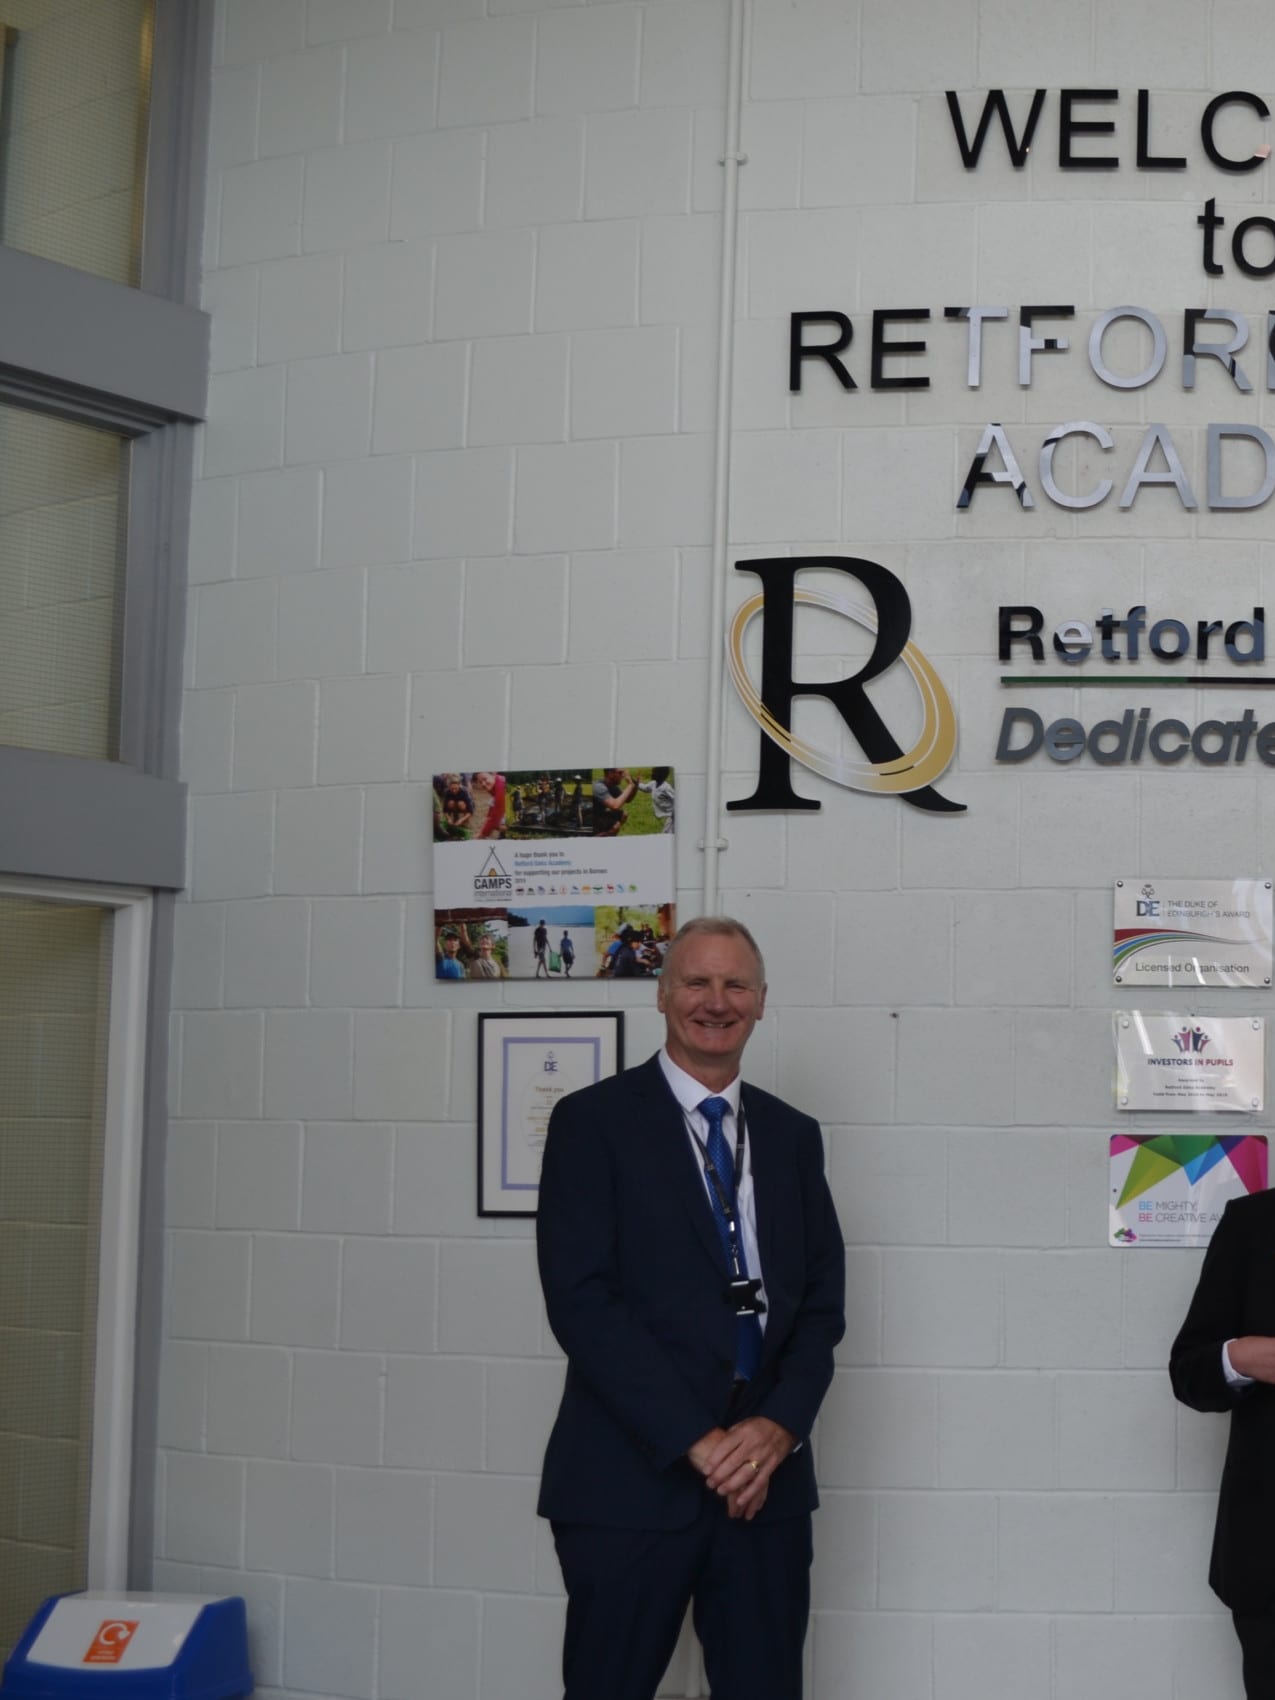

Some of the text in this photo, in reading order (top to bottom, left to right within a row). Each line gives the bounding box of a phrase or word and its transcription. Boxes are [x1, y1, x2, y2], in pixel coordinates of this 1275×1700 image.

[998, 605, 1265, 663] Retford
[474, 878, 512, 890] CAMPS
[1168, 900, 1218, 909] THE DUKE OF
[1167, 910, 1250, 919] EDINBURGH'S AWARD
[1135, 962, 1181, 973] Licensed
[1148, 1058, 1234, 1067] INVESTORS IN PUPILS
[1138, 1201, 1153, 1211] BE
[1138, 1213, 1153, 1222] BE
[1155, 1213, 1207, 1223] CREATIVE
